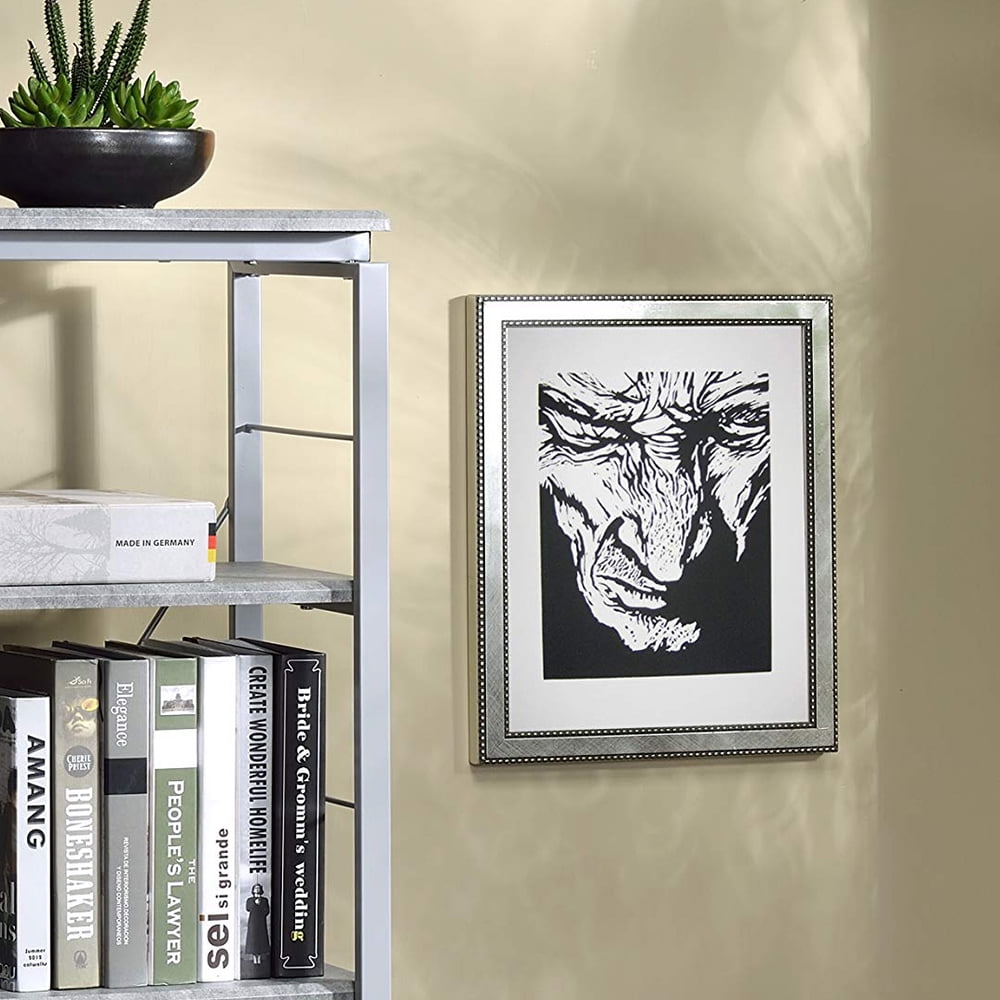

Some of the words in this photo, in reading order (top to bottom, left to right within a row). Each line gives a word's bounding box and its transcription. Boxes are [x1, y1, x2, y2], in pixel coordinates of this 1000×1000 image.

[115, 539, 140, 547] MADE
[142, 539, 150, 547] IN
[153, 538, 195, 547] GERMANY
[111, 682, 134, 747] Elegance
[248, 666, 267, 714] CREATE
[296, 686, 312, 742] Bride
[248, 718, 267, 803] WONDERFUL
[296, 745, 311, 763] &
[26, 734, 46, 850] AMANG
[295, 767, 311, 854] Gromm's
[167, 780, 184, 876] PEOPLE'S
[216, 828, 232, 888] grande
[249, 807, 267, 874] HOMELIFE
[66, 786, 94, 941] BONESHAKER
[188, 859, 196, 884] THE
[167, 881, 184, 965] LAWYER
[216, 895, 228, 908] si
[290, 862, 309, 942] wedding
